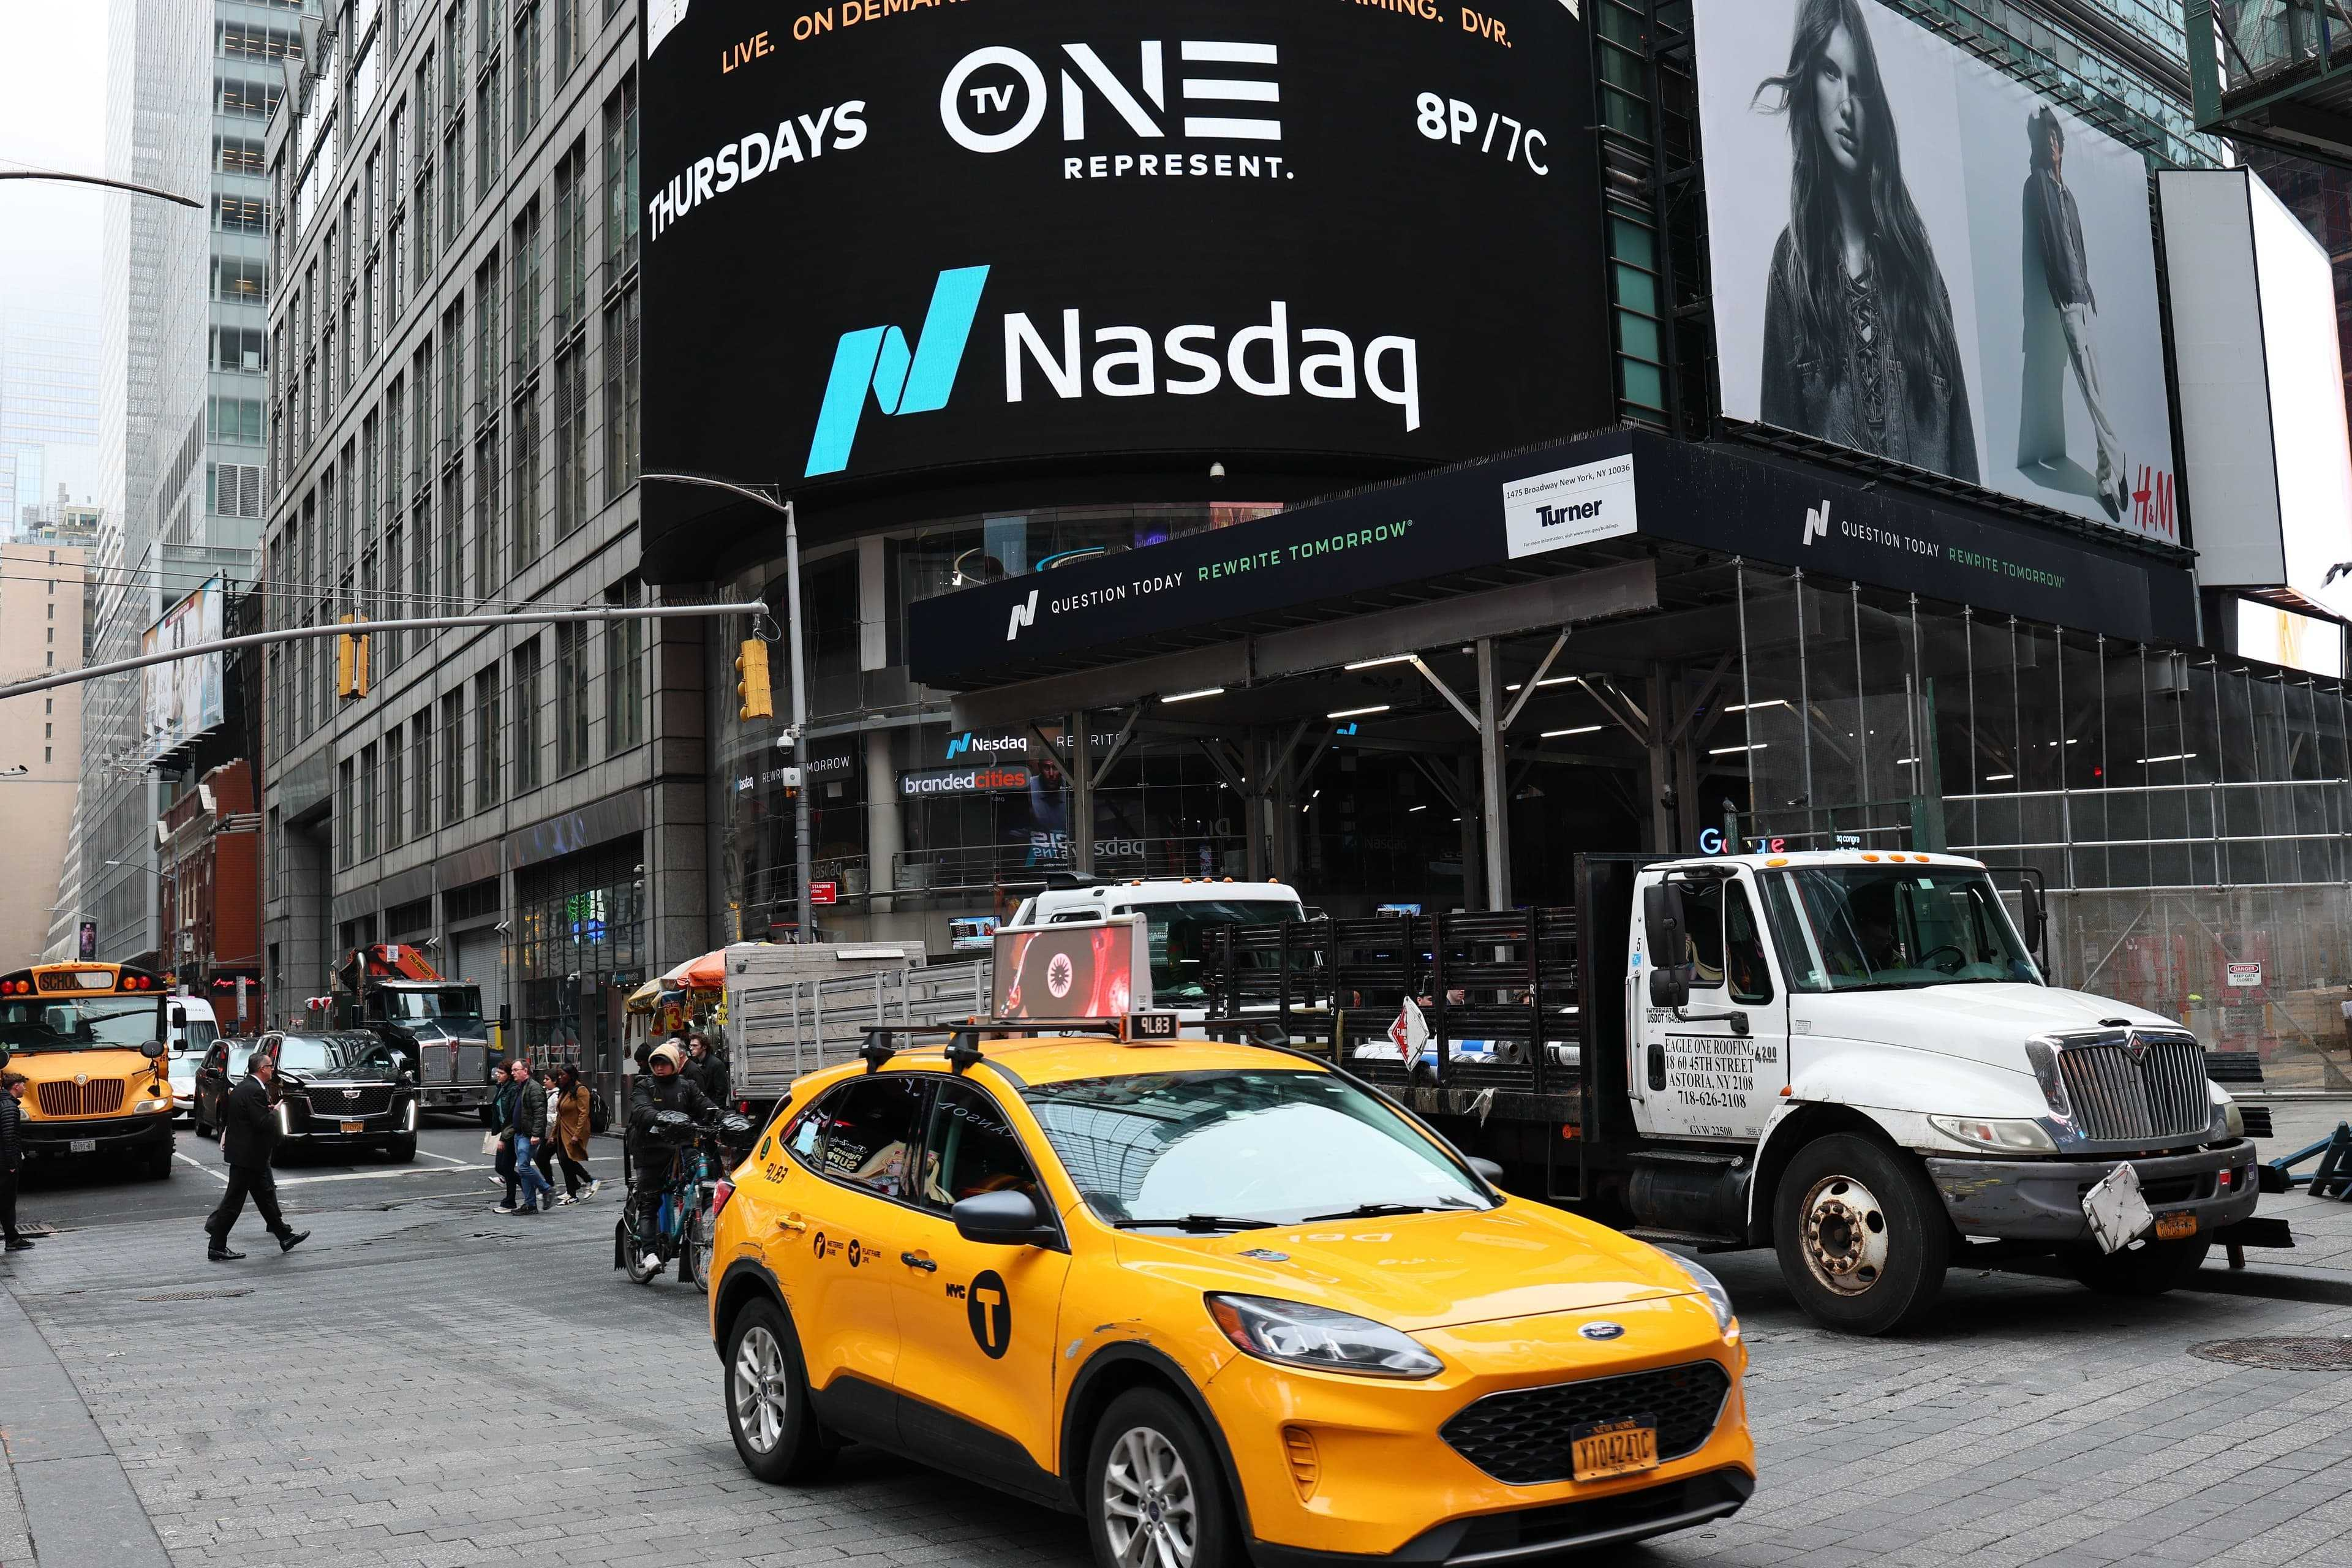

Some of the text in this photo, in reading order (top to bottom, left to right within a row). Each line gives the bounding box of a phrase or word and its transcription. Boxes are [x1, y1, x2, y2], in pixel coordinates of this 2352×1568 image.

[723, 31, 775, 74] LIVE.
[793, 8, 833, 40] ON
[1462, 7, 1512, 48] DVR.
[940, 40, 1281, 153] TV ONE
[1417, 92, 1548, 175] 8P/7C
[649, 100, 867, 241] THURSDAYS
[1065, 154, 1294, 179] REPRESENT.
[1005, 301, 1420, 432] Nasdaq
[1506, 489, 1523, 499] 1475
[1525, 481, 1558, 495] Broadway
[1559, 478, 1575, 486] New
[1577, 470, 1594, 481] York,
[1608, 464, 1630, 475] 10036
[2132, 463, 2173, 540] H&M
[1536, 499, 1602, 527] Turner
[1841, 521, 1900, 549] QUESTION
[1905, 537, 1939, 557] TODAY
[1949, 547, 1998, 572] REWRITE
[1052, 584, 1126, 613] QUESTION
[1133, 571, 1183, 597] TODAY
[1198, 549, 1281, 581] REWRITE
[973, 736, 1027, 752] Nasdaq
[1057, 734, 1120, 747] RERIT
[763, 767, 793, 783] REWRI
[905, 769, 1025, 793] brandedcities
[1637, 938, 1641, 951] 5
[1529, 984, 1534, 994] R
[1224, 999, 1227, 1008] R
[1330, 996, 1334, 1005] R
[1142, 1017, 1169, 1033] 9L83
[1647, 1014, 1664, 1023] USDOT
[1665, 1038, 1754, 1056] EAGLE ONE ROOFING
[1666, 1055, 1754, 1073] 18 60 45TH STREET
[1669, 1072, 1754, 1091] ASTORIA, NY 2108
[1678, 1090, 1746, 1109] 718-626-2108
[1690, 1125, 1733, 1137] GVW 22500
[765, 1163, 788, 1183] 9L83
[946, 1283, 1001, 1348] NYC T
